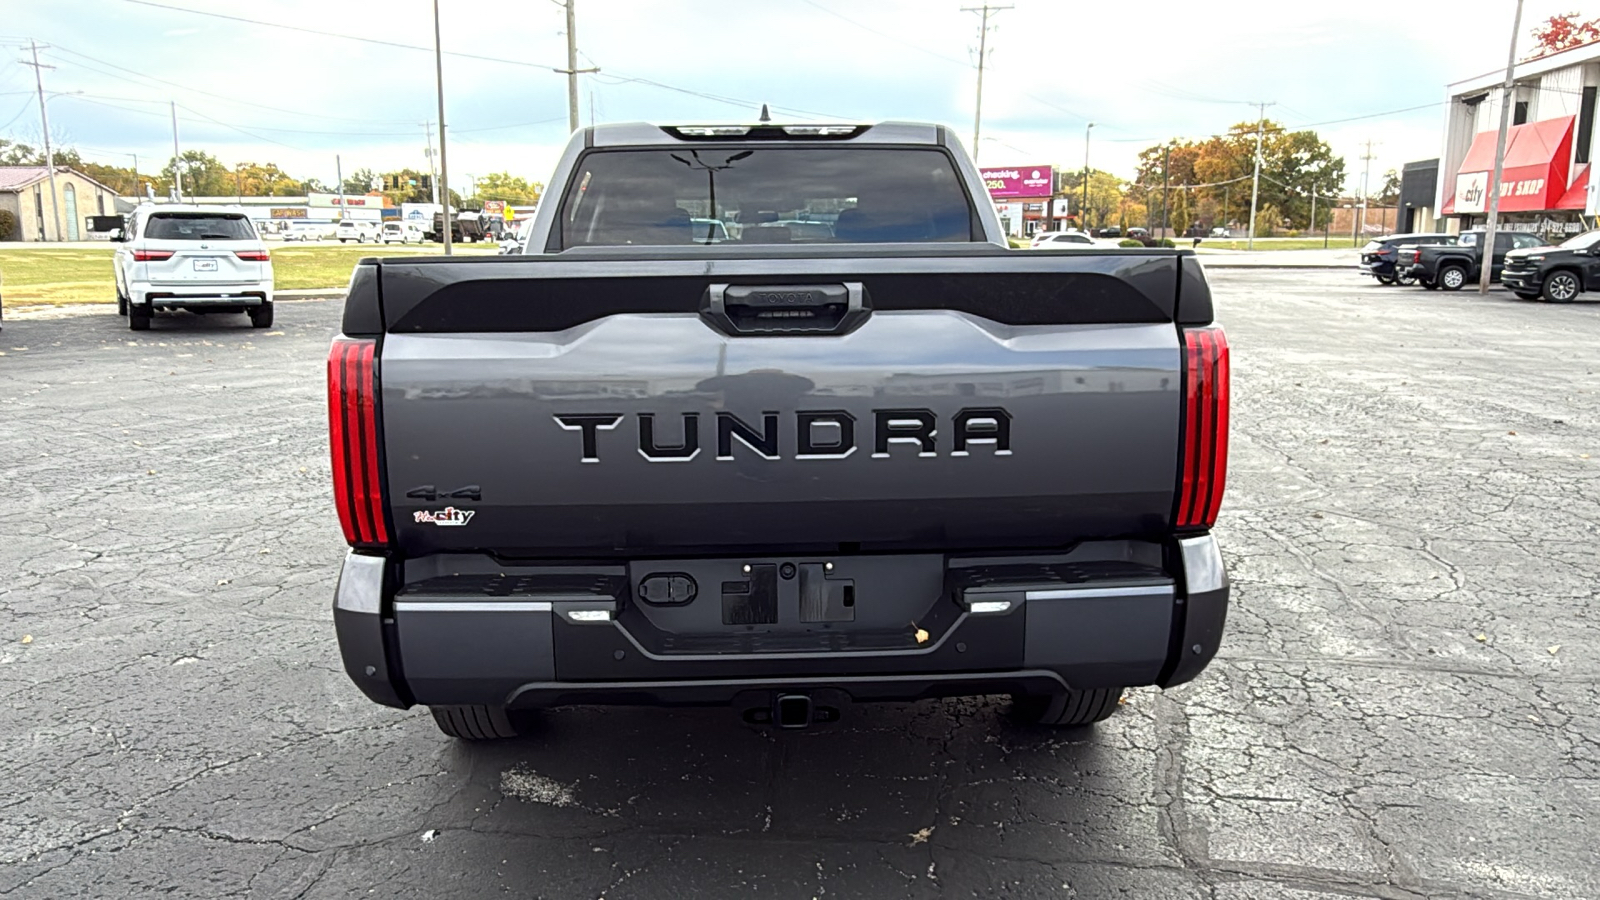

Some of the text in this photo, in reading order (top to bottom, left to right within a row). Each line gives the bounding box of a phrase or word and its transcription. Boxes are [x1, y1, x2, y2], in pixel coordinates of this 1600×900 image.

[1465, 179, 1484, 207] city
[1514, 178, 1545, 196] SHOP
[759, 292, 814, 303] TOYOTA
[552, 407, 1013, 463] TUNDRA
